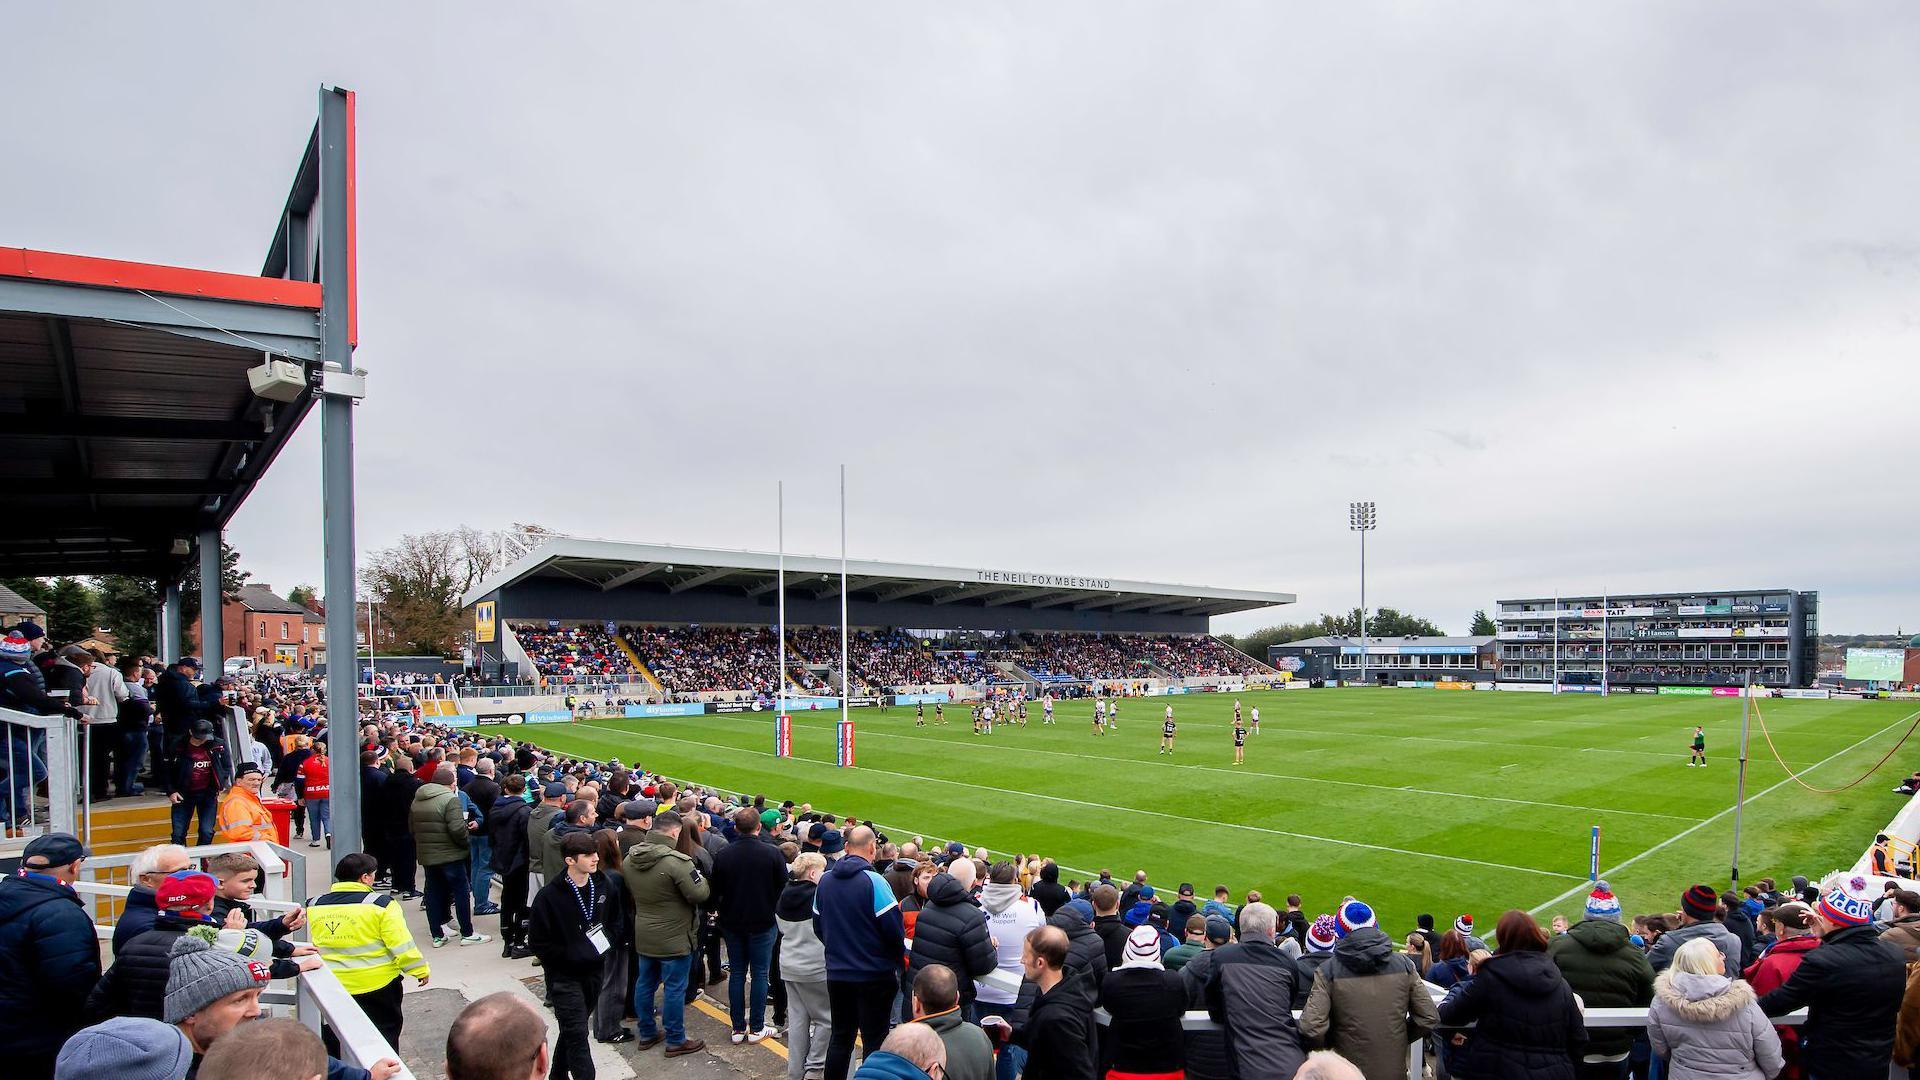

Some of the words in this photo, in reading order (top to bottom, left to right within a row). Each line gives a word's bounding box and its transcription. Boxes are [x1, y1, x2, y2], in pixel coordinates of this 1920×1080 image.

[977, 570, 1000, 581] THE
[1003, 572, 1028, 583] NEIL
[1031, 575, 1052, 585] FOX
[1055, 576, 1076, 586] MBE
[1079, 579, 1111, 589] STAND
